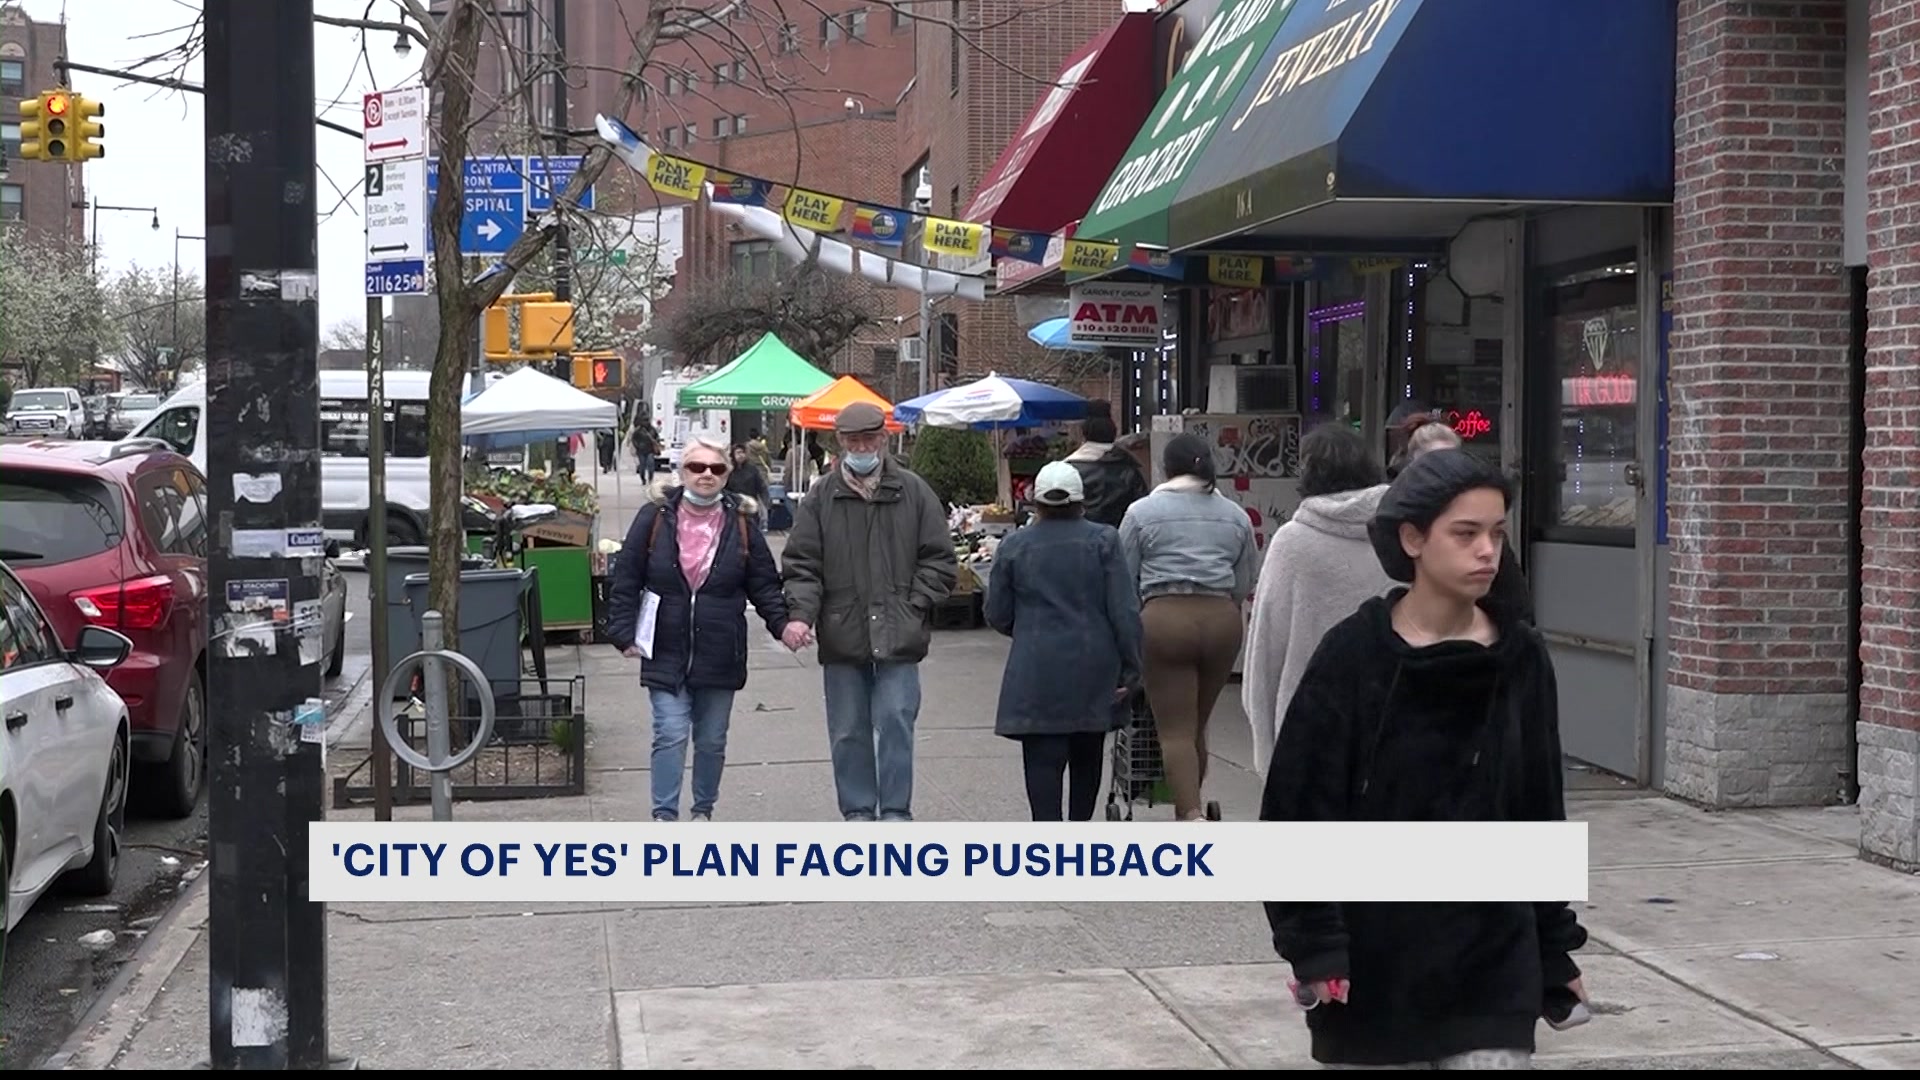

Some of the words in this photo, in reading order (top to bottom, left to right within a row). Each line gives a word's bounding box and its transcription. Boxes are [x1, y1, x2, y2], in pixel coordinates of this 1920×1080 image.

[1232, 0, 1402, 131] JEWELRY
[470, 162, 516, 174] CENTRA
[656, 160, 692, 177] PLAY
[1096, 115, 1218, 215] GROCERY
[369, 166, 379, 194] 2
[464, 175, 493, 187] RONX
[466, 198, 514, 213] SPITAL
[795, 194, 831, 210] PLAY
[935, 223, 970, 237] PLAY
[1074, 244, 1109, 258] PLAY
[1218, 257, 1250, 269] PLAY
[1073, 302, 1158, 325] ATM
[1107, 324, 1128, 333] $20
[1595, 374, 1632, 404] GOLD
[1447, 411, 1490, 437] Coffee
